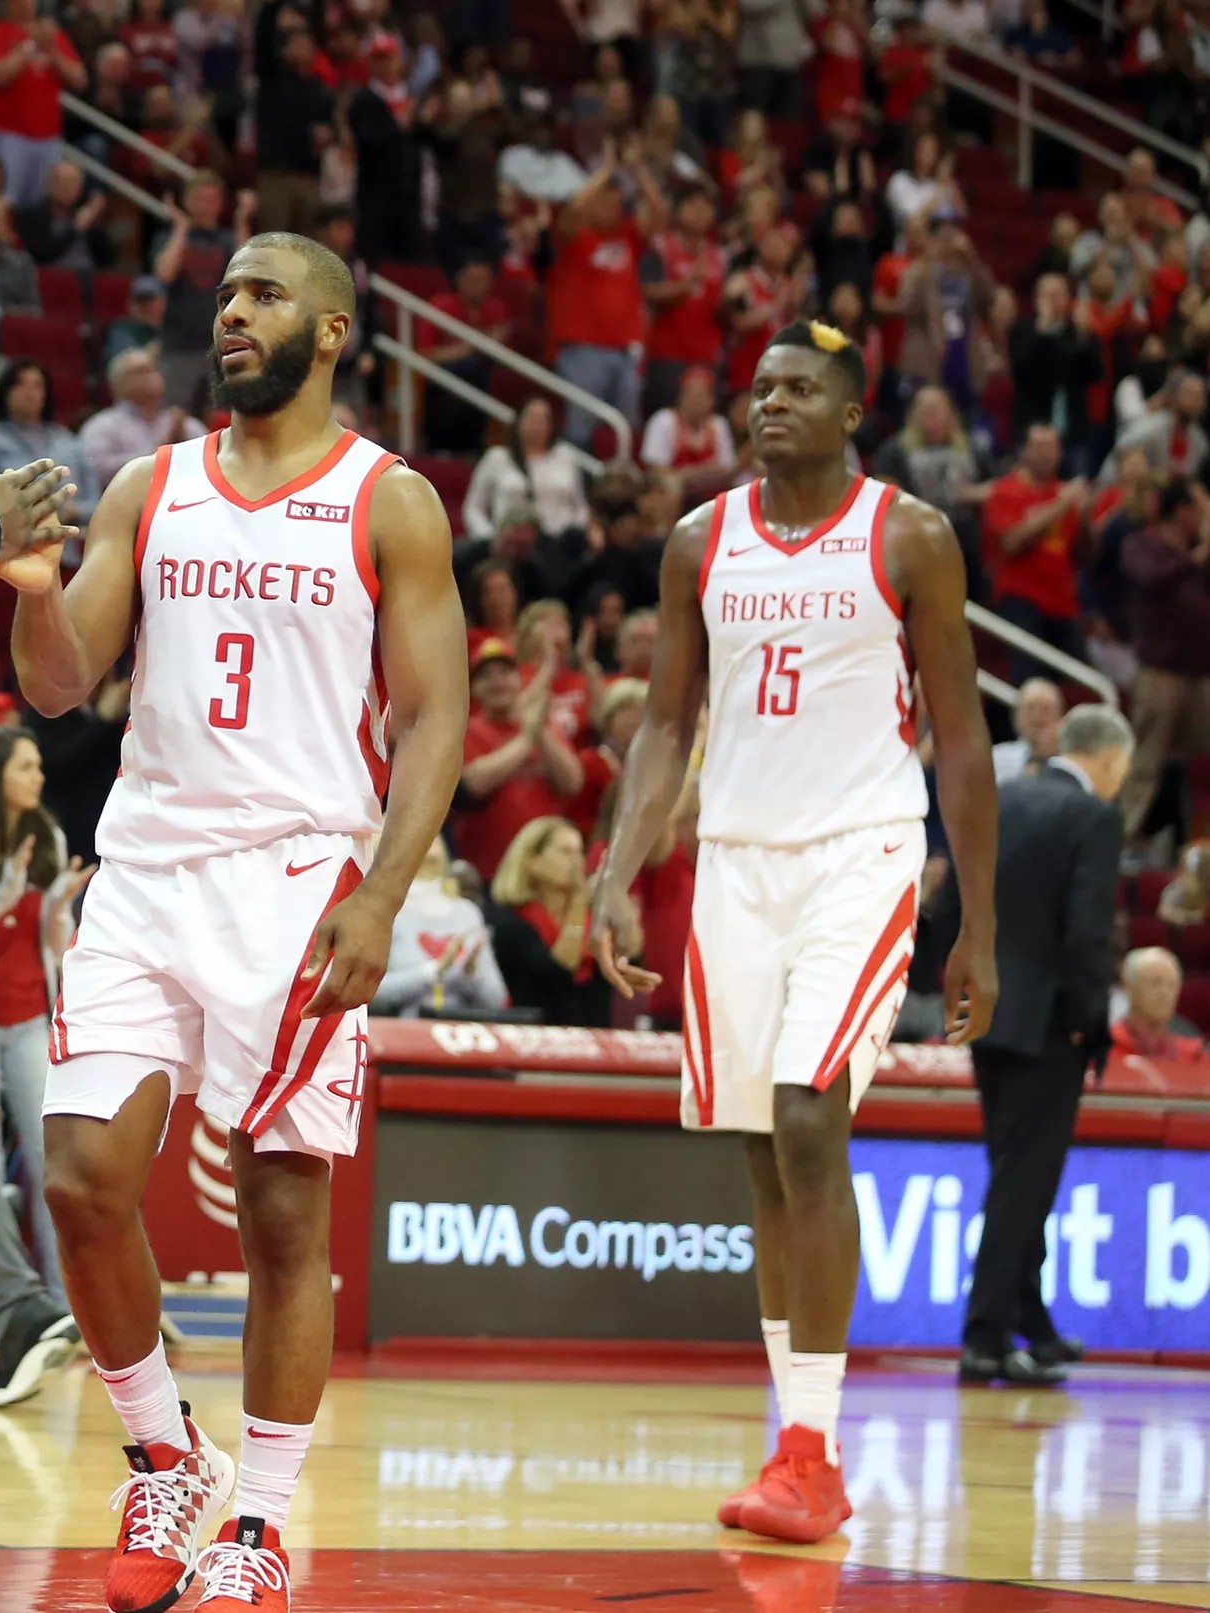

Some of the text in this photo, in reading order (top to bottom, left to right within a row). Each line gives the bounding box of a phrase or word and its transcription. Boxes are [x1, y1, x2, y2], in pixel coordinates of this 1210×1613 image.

[156, 552, 337, 607] ROCKETS
[722, 590, 857, 624] ROCKETS
[208, 632, 255, 730] 3
[757, 643, 802, 716] 15
[388, 1201, 755, 1282] BBVA Compass
